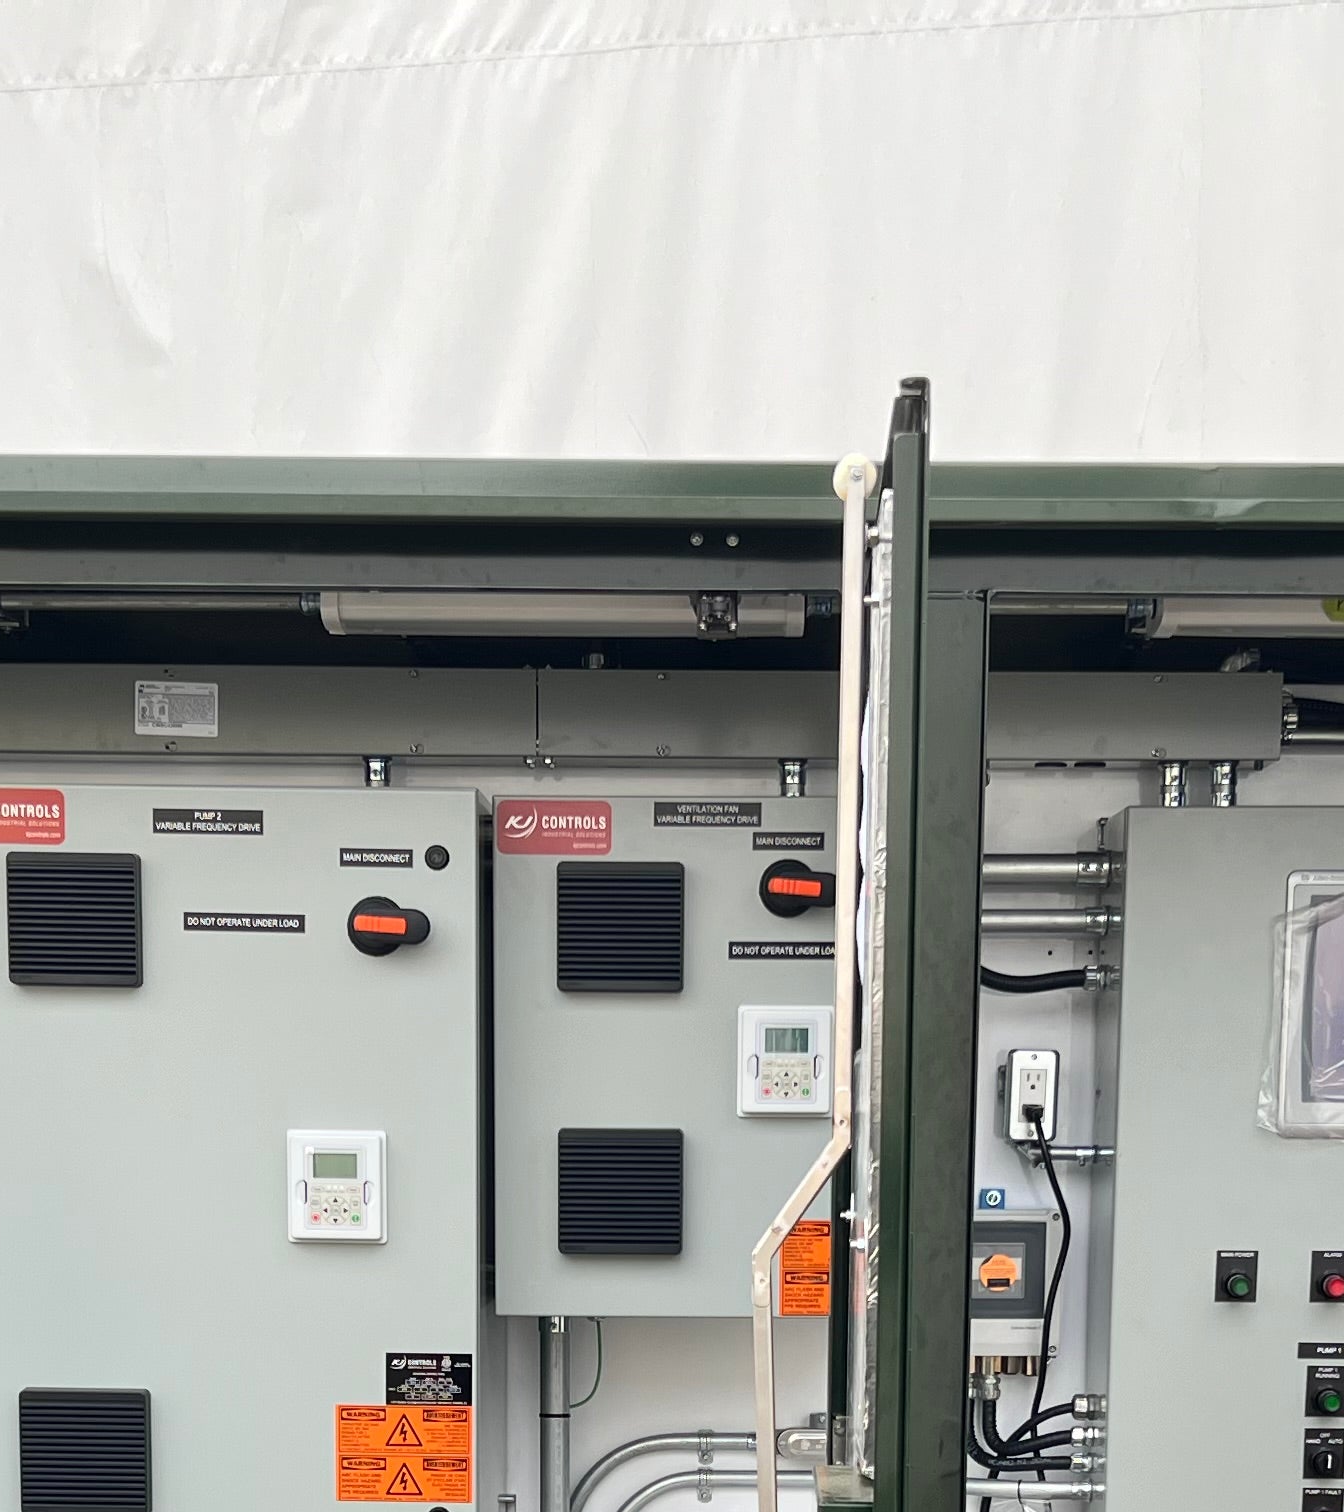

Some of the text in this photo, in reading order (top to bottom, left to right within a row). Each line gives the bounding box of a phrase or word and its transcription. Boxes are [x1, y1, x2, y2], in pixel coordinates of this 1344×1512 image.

[677, 805, 739, 814] VENTILATION FAN
[194, 812, 221, 820] PUMP 2
[656, 815, 758, 824] VARIABLE FREQUENCY DRIVE
[156, 822, 261, 832] VARIABLE FREQUENCY DRIVE
[542, 815, 607, 830] CONTROLS
[756, 837, 820, 846] MAIN DISCONNECT
[343, 853, 410, 863] MAIN DISCONNECT
[187, 917, 300, 928] DO NOT OPERATE UNDER LOAD
[732, 945, 834, 956] DO NOT OPERATE UNDER LOA
